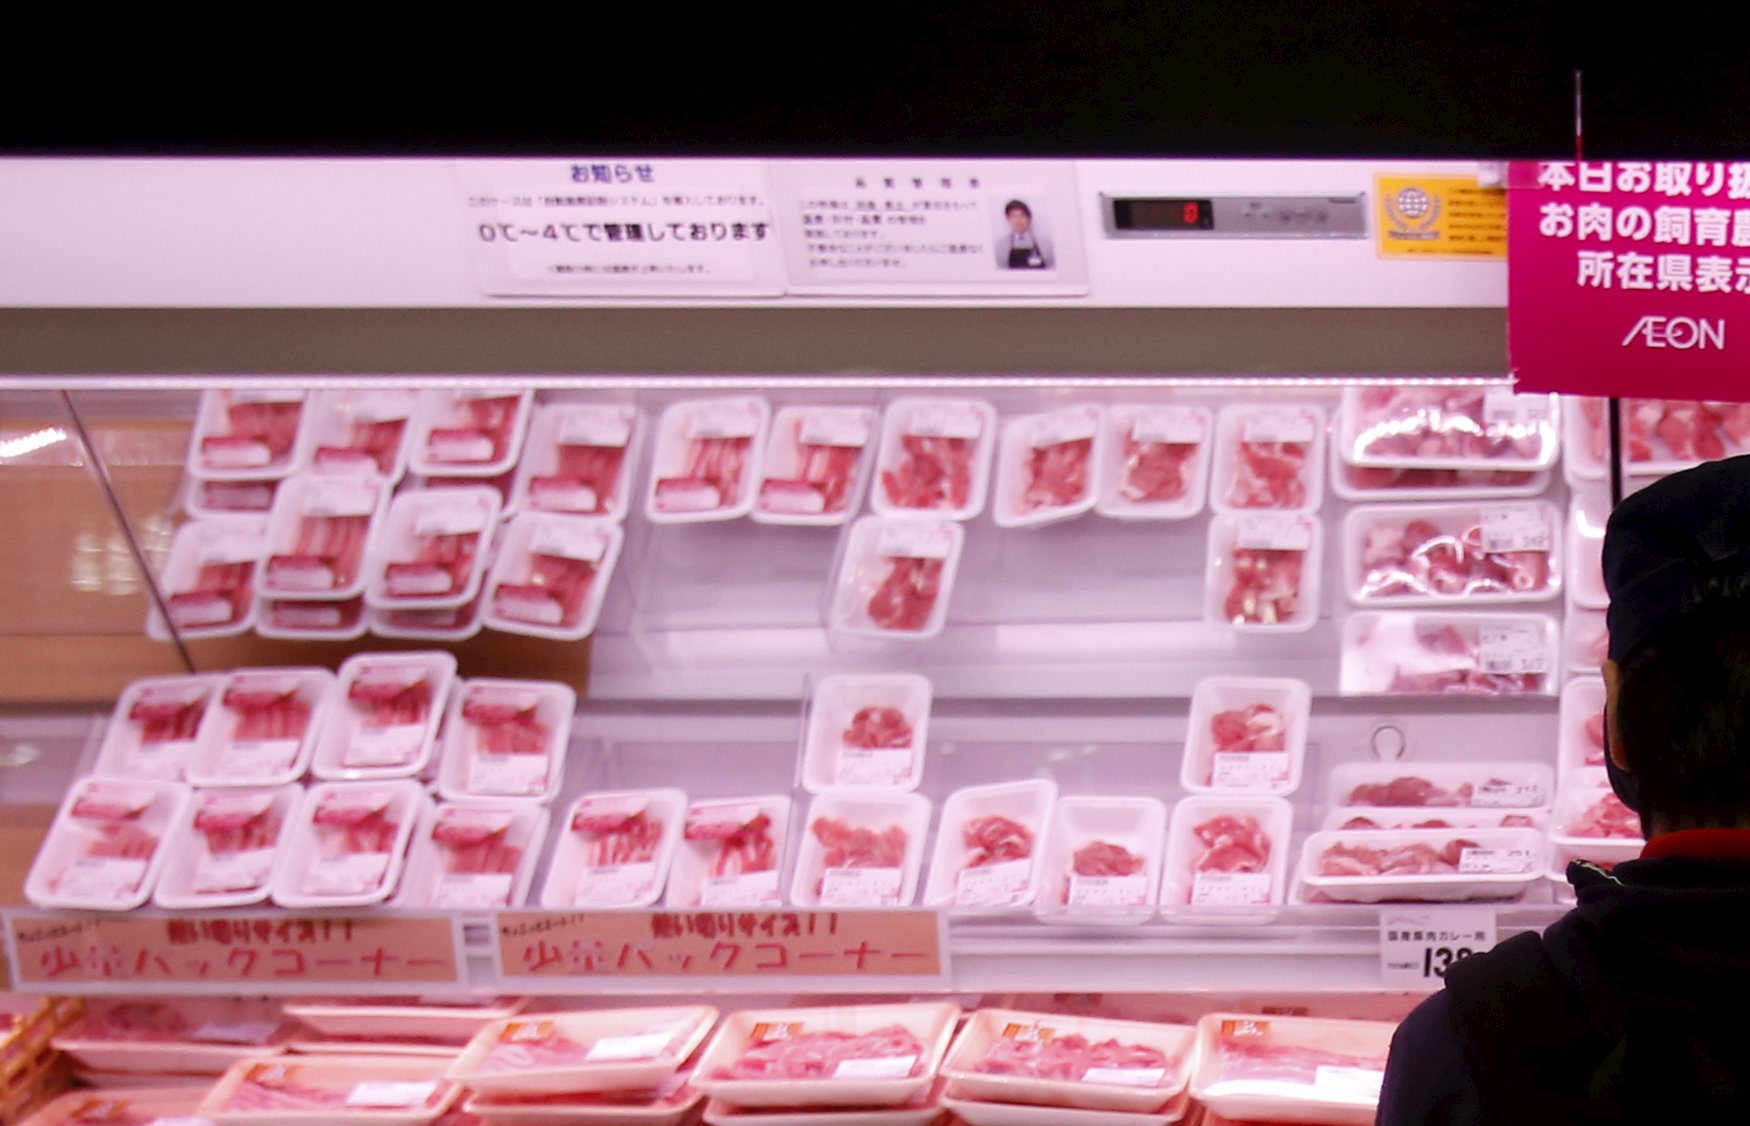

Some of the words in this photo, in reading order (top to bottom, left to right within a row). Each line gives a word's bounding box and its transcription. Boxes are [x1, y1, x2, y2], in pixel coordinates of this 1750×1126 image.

[570, 165, 655, 184] お知らせ
[1183, 202, 1200, 224] 0
